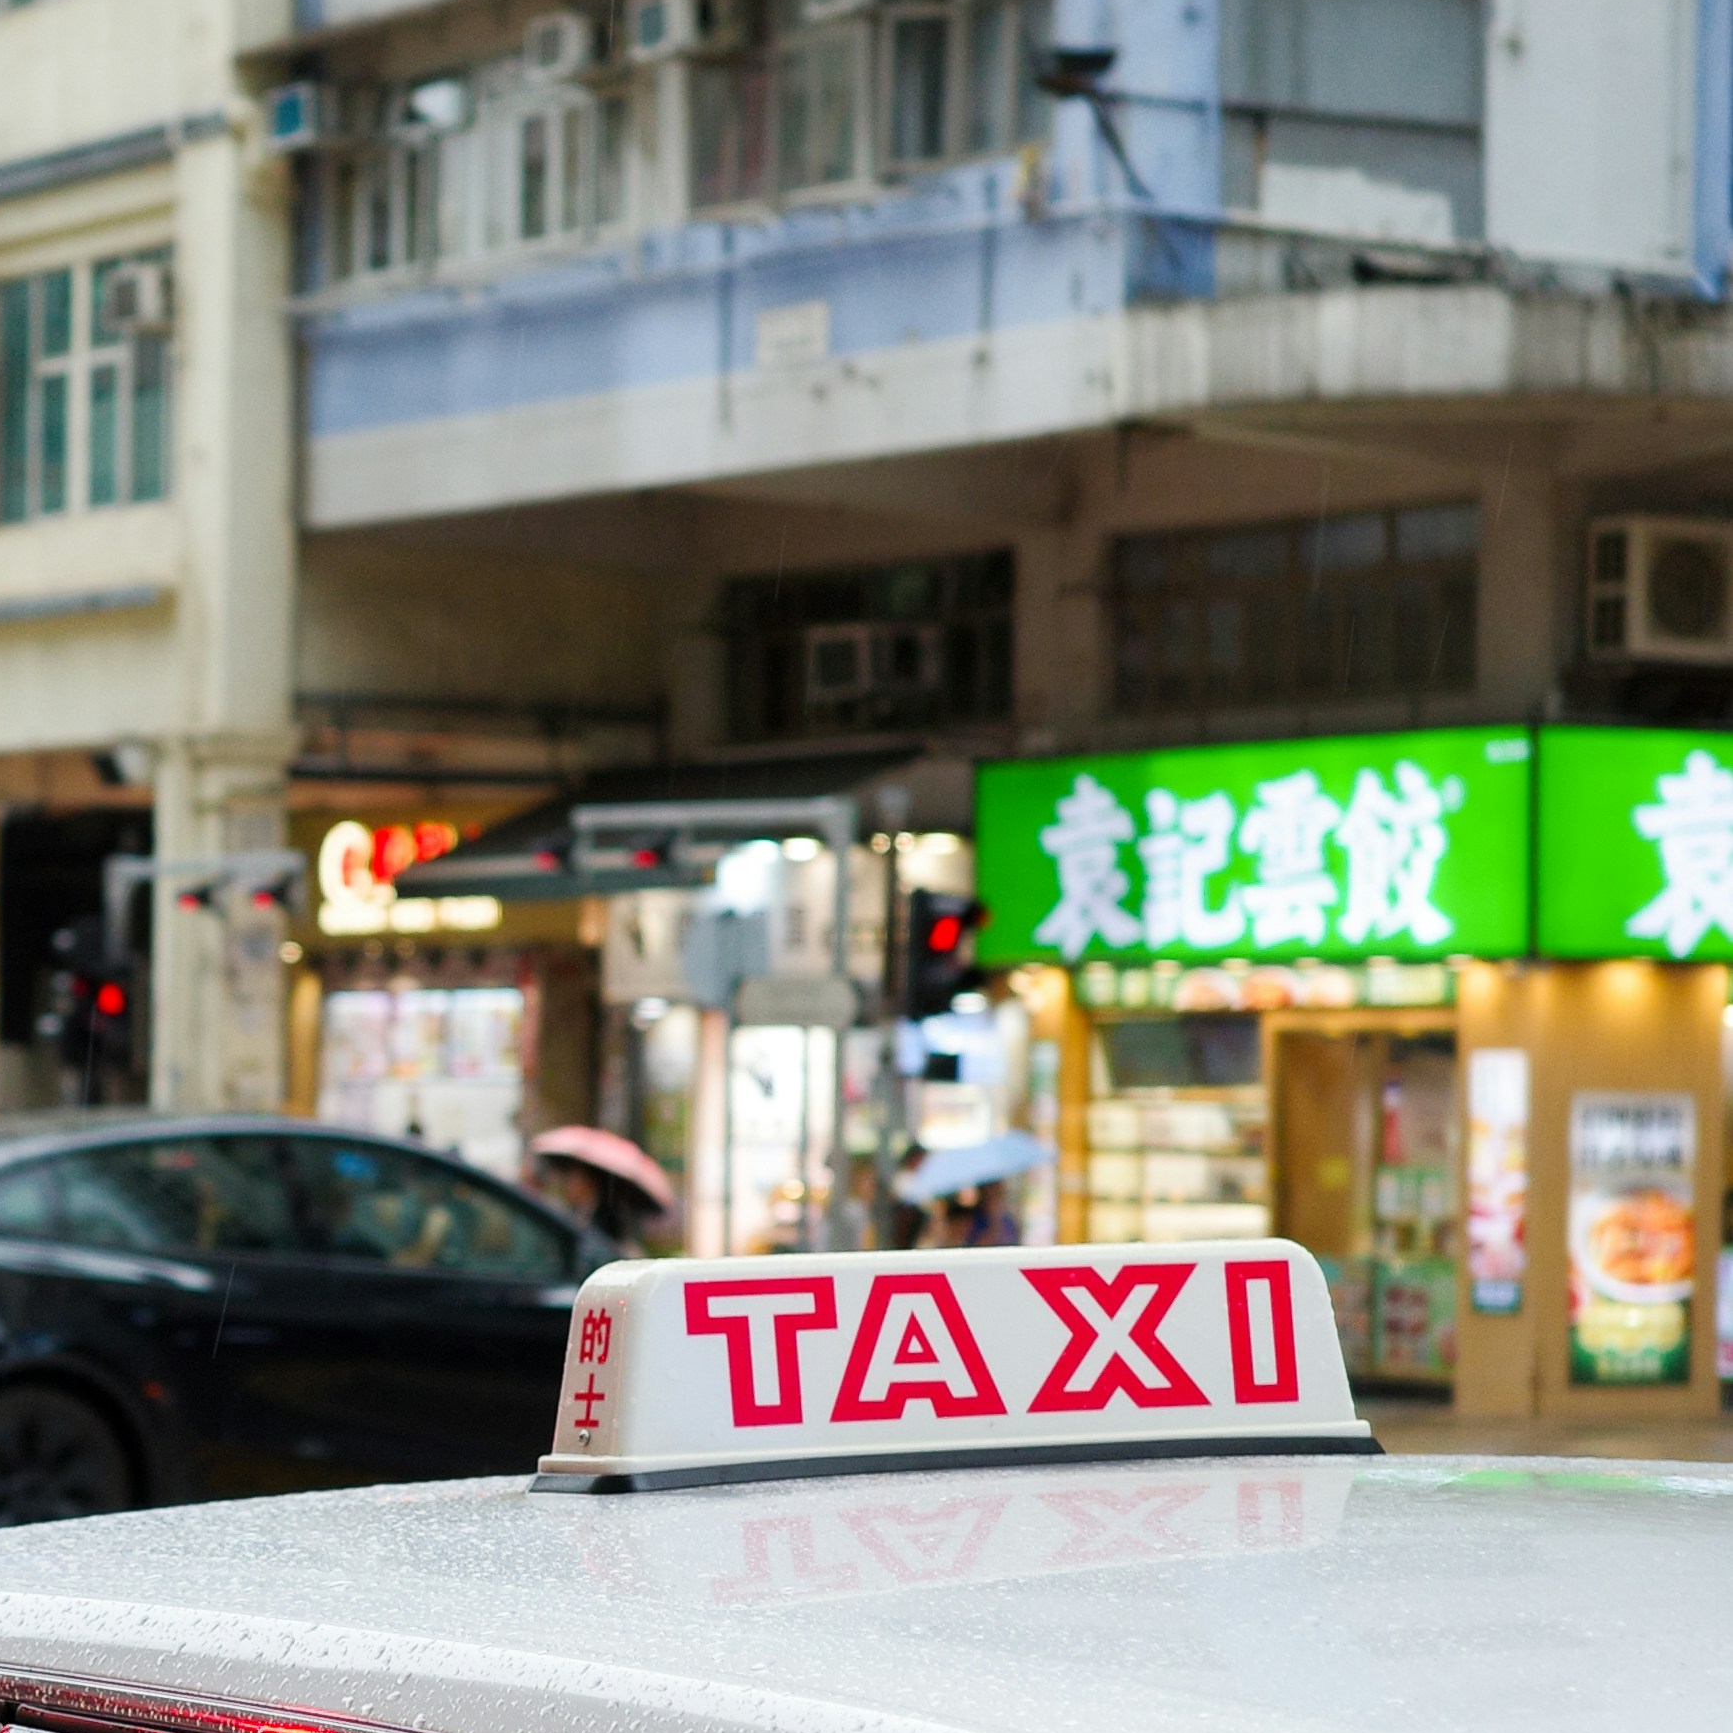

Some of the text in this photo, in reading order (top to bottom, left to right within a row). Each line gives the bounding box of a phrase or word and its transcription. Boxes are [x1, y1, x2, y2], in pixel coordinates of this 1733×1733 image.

[1034, 759, 1455, 962] 袁記雲餃
[574, 1307, 613, 1428] 的士
[683, 1260, 1301, 1428] TAXI
